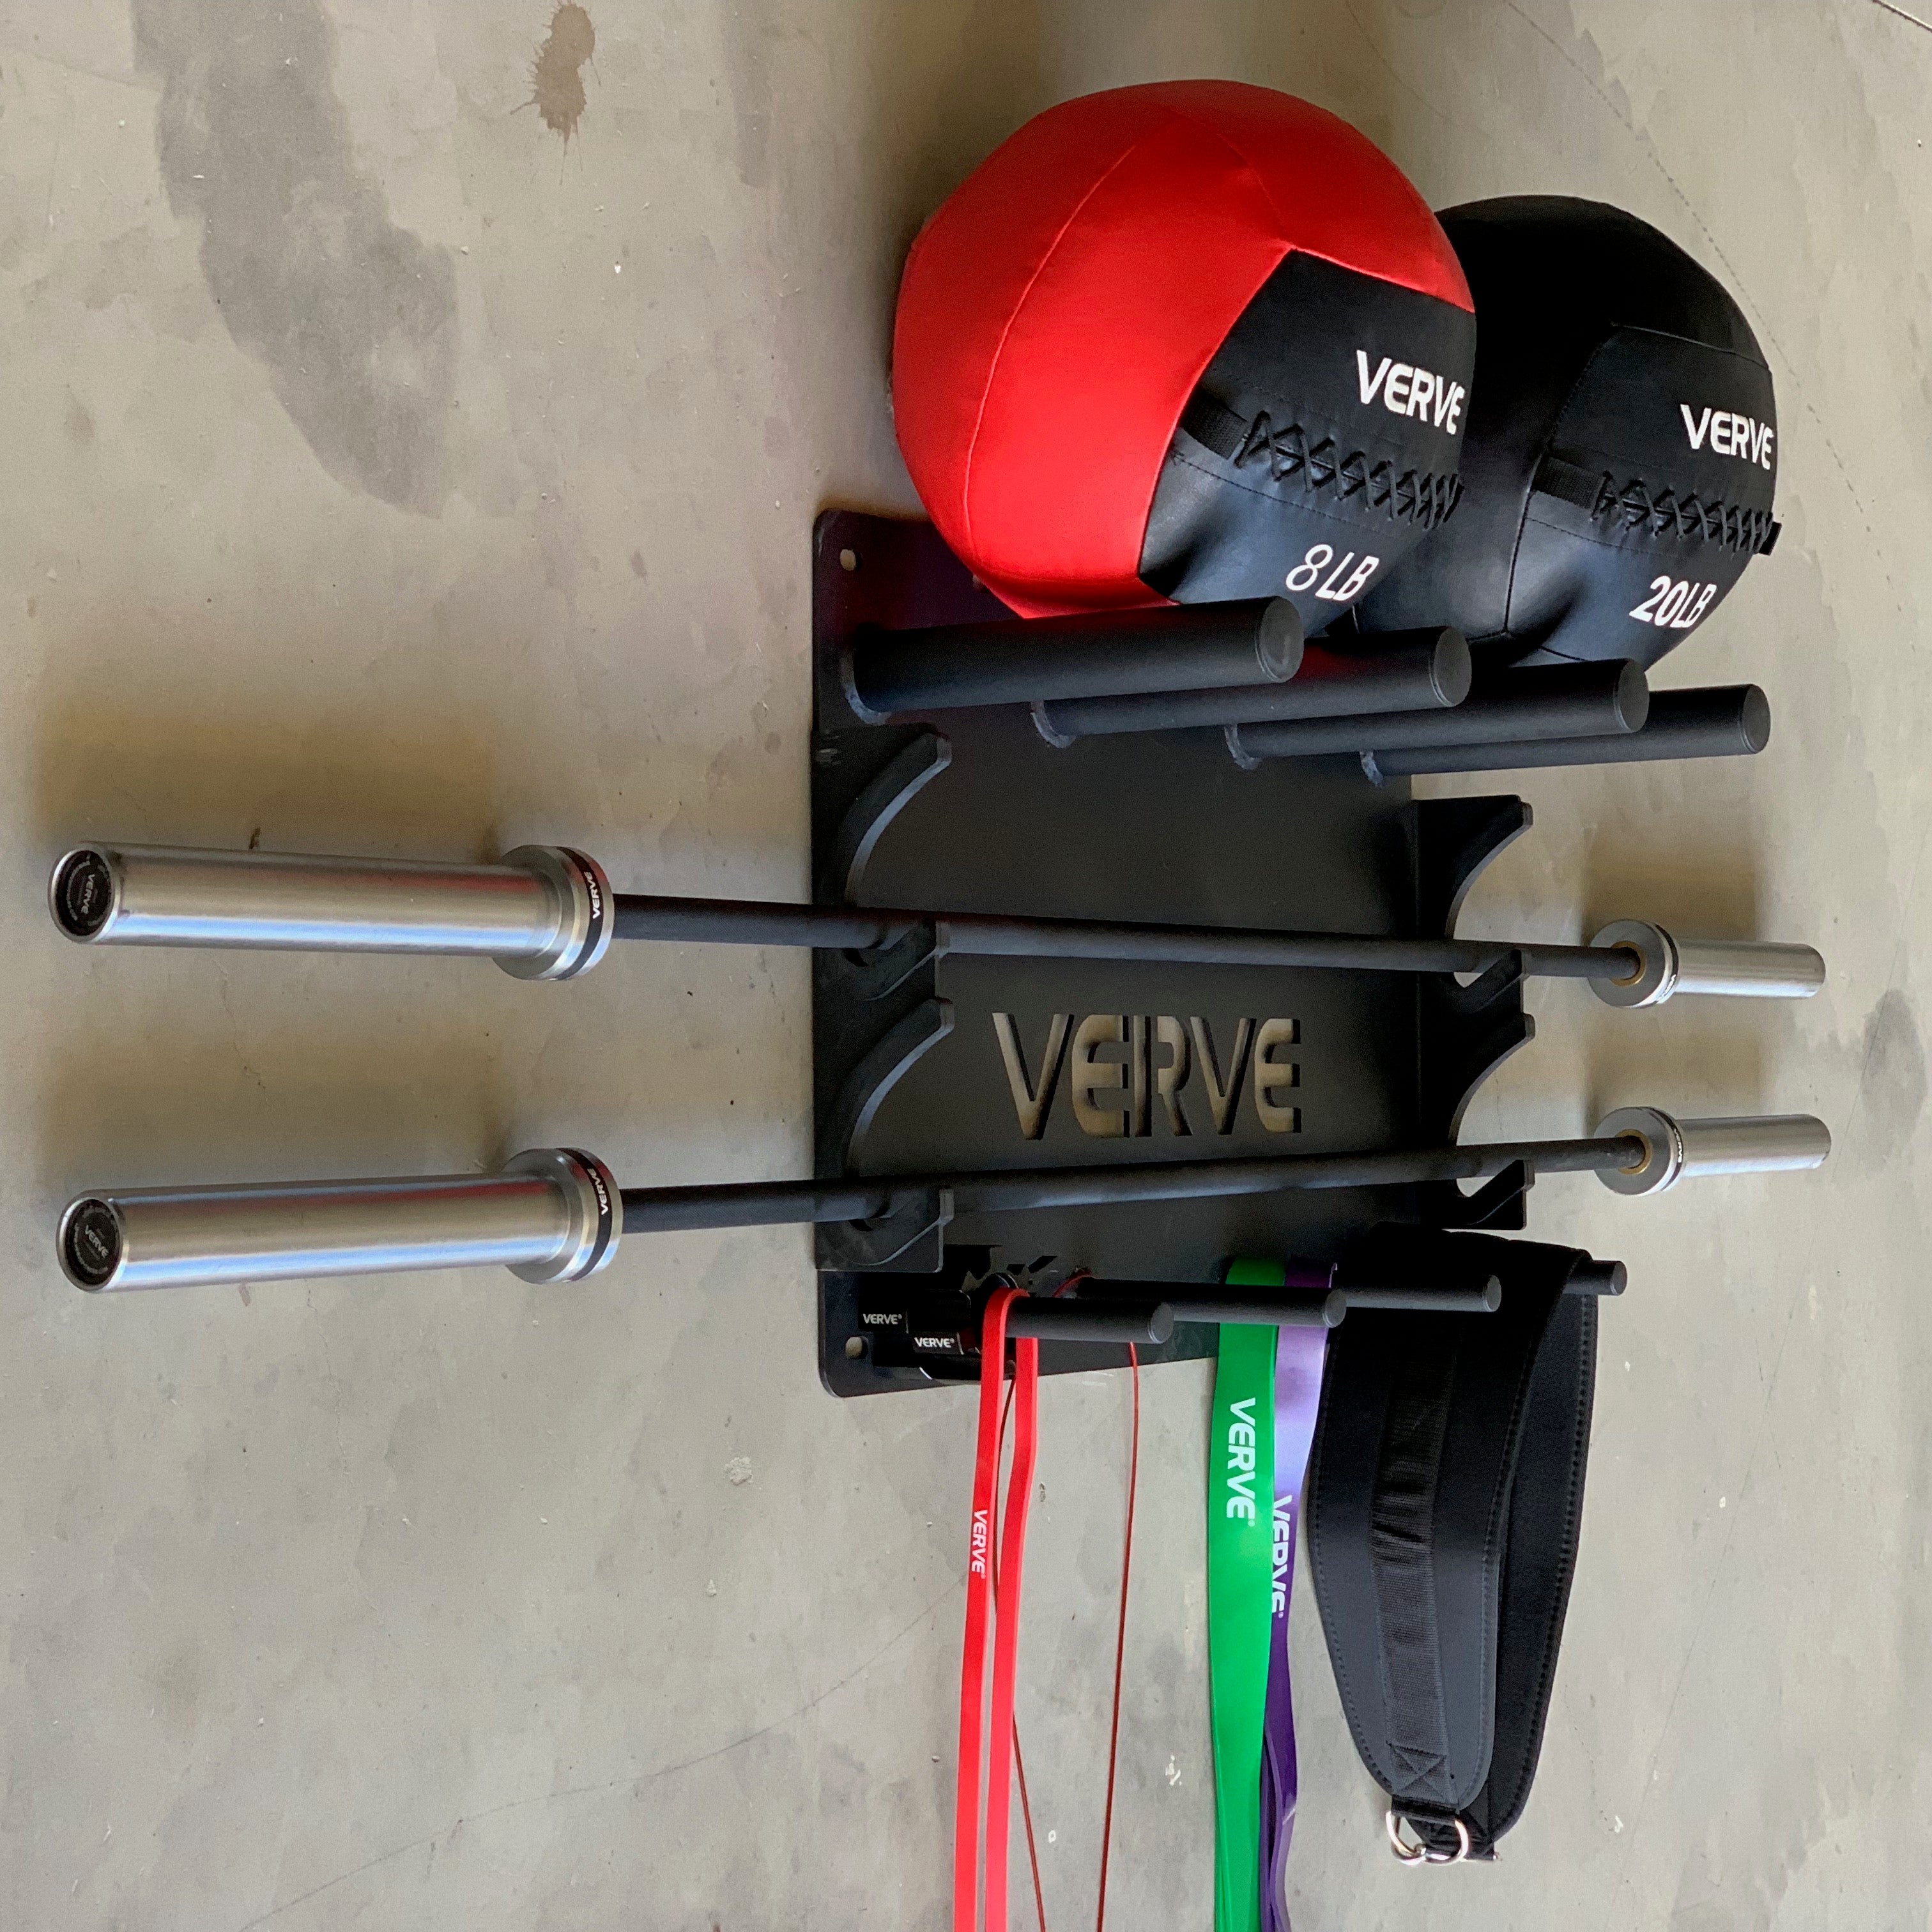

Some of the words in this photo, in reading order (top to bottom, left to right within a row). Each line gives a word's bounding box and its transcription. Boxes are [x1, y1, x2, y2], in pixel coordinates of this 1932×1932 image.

[1356, 349, 1465, 435] VERVE
[1680, 404, 1774, 470] VERVE
[1629, 575, 1717, 628] 20LB
[81, 874, 95, 914] VERVE
[584, 871, 601, 919] VERVE
[992, 1012, 1302, 1140] VERVE
[587, 1168, 609, 1215] VERVE
[85, 1225, 109, 1259] VERVE
[1226, 1397, 1257, 1519] VERVE
[971, 1509, 988, 1574] VERVE
